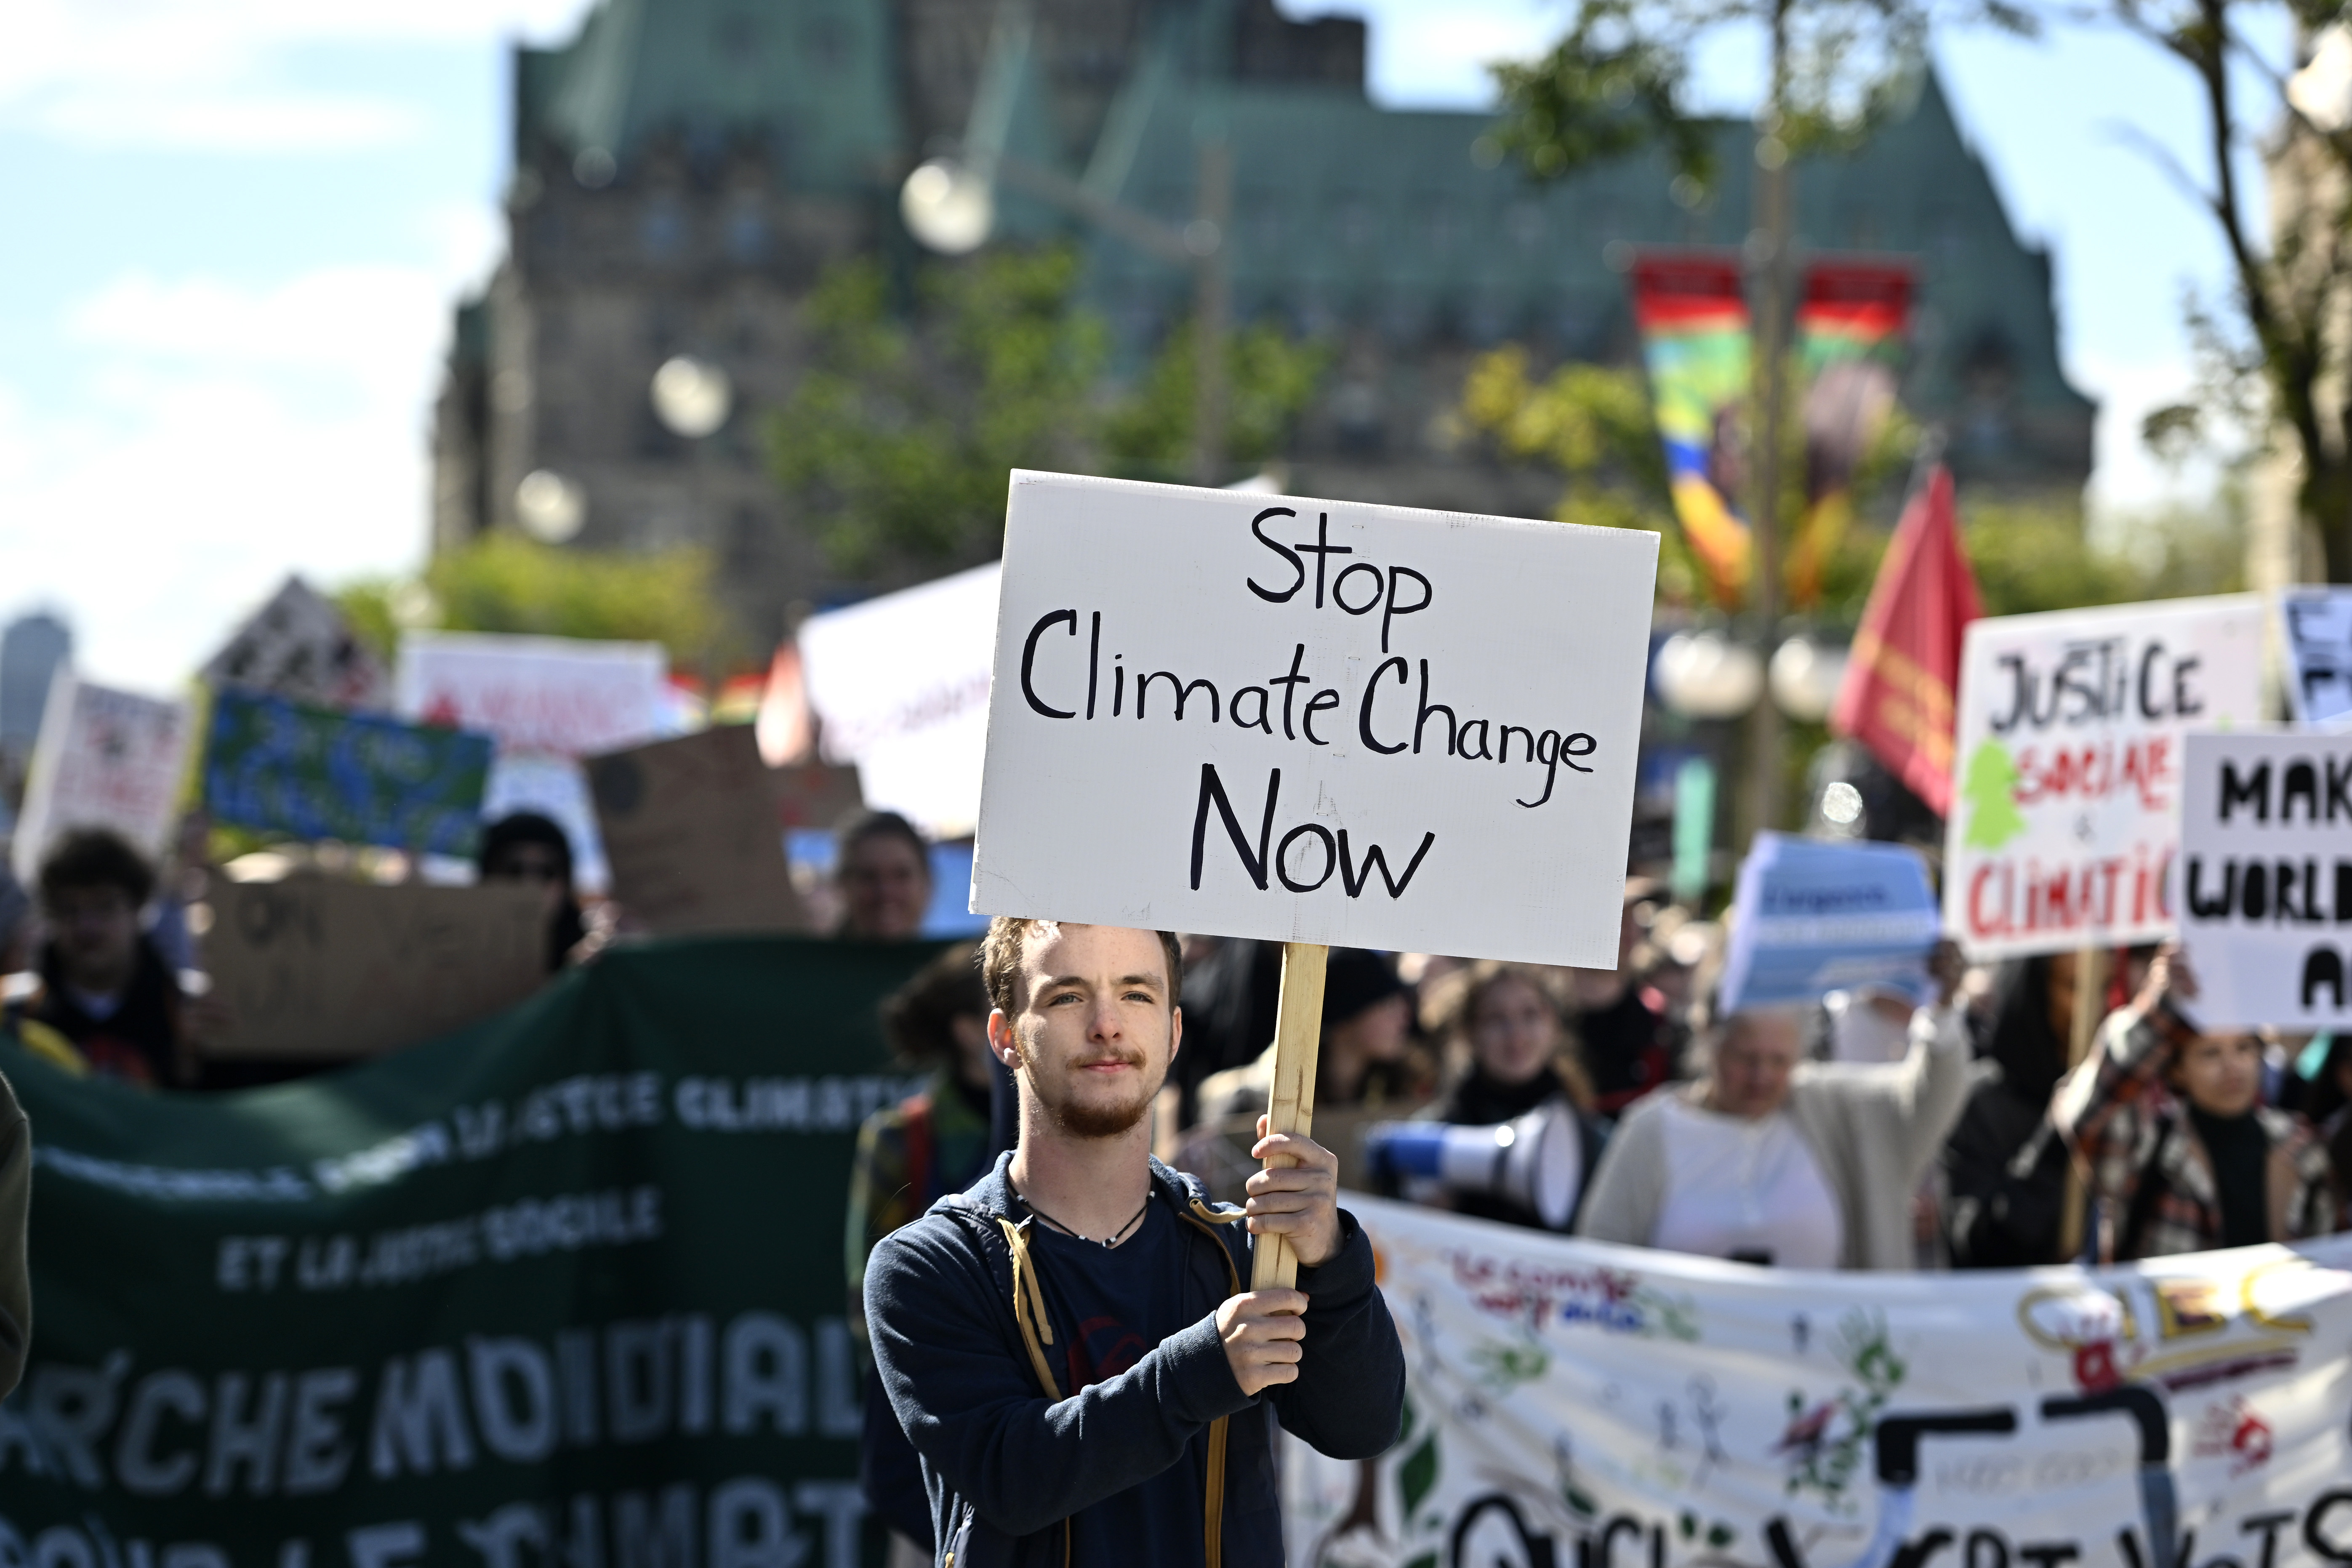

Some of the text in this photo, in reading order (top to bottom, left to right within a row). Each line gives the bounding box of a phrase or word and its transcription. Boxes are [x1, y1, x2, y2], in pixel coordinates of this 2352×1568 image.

[1247, 507, 1432, 653] Stop
[1021, 609, 1340, 745] Climate
[1359, 657, 1597, 808] Change
[1191, 763, 1436, 900] Now
